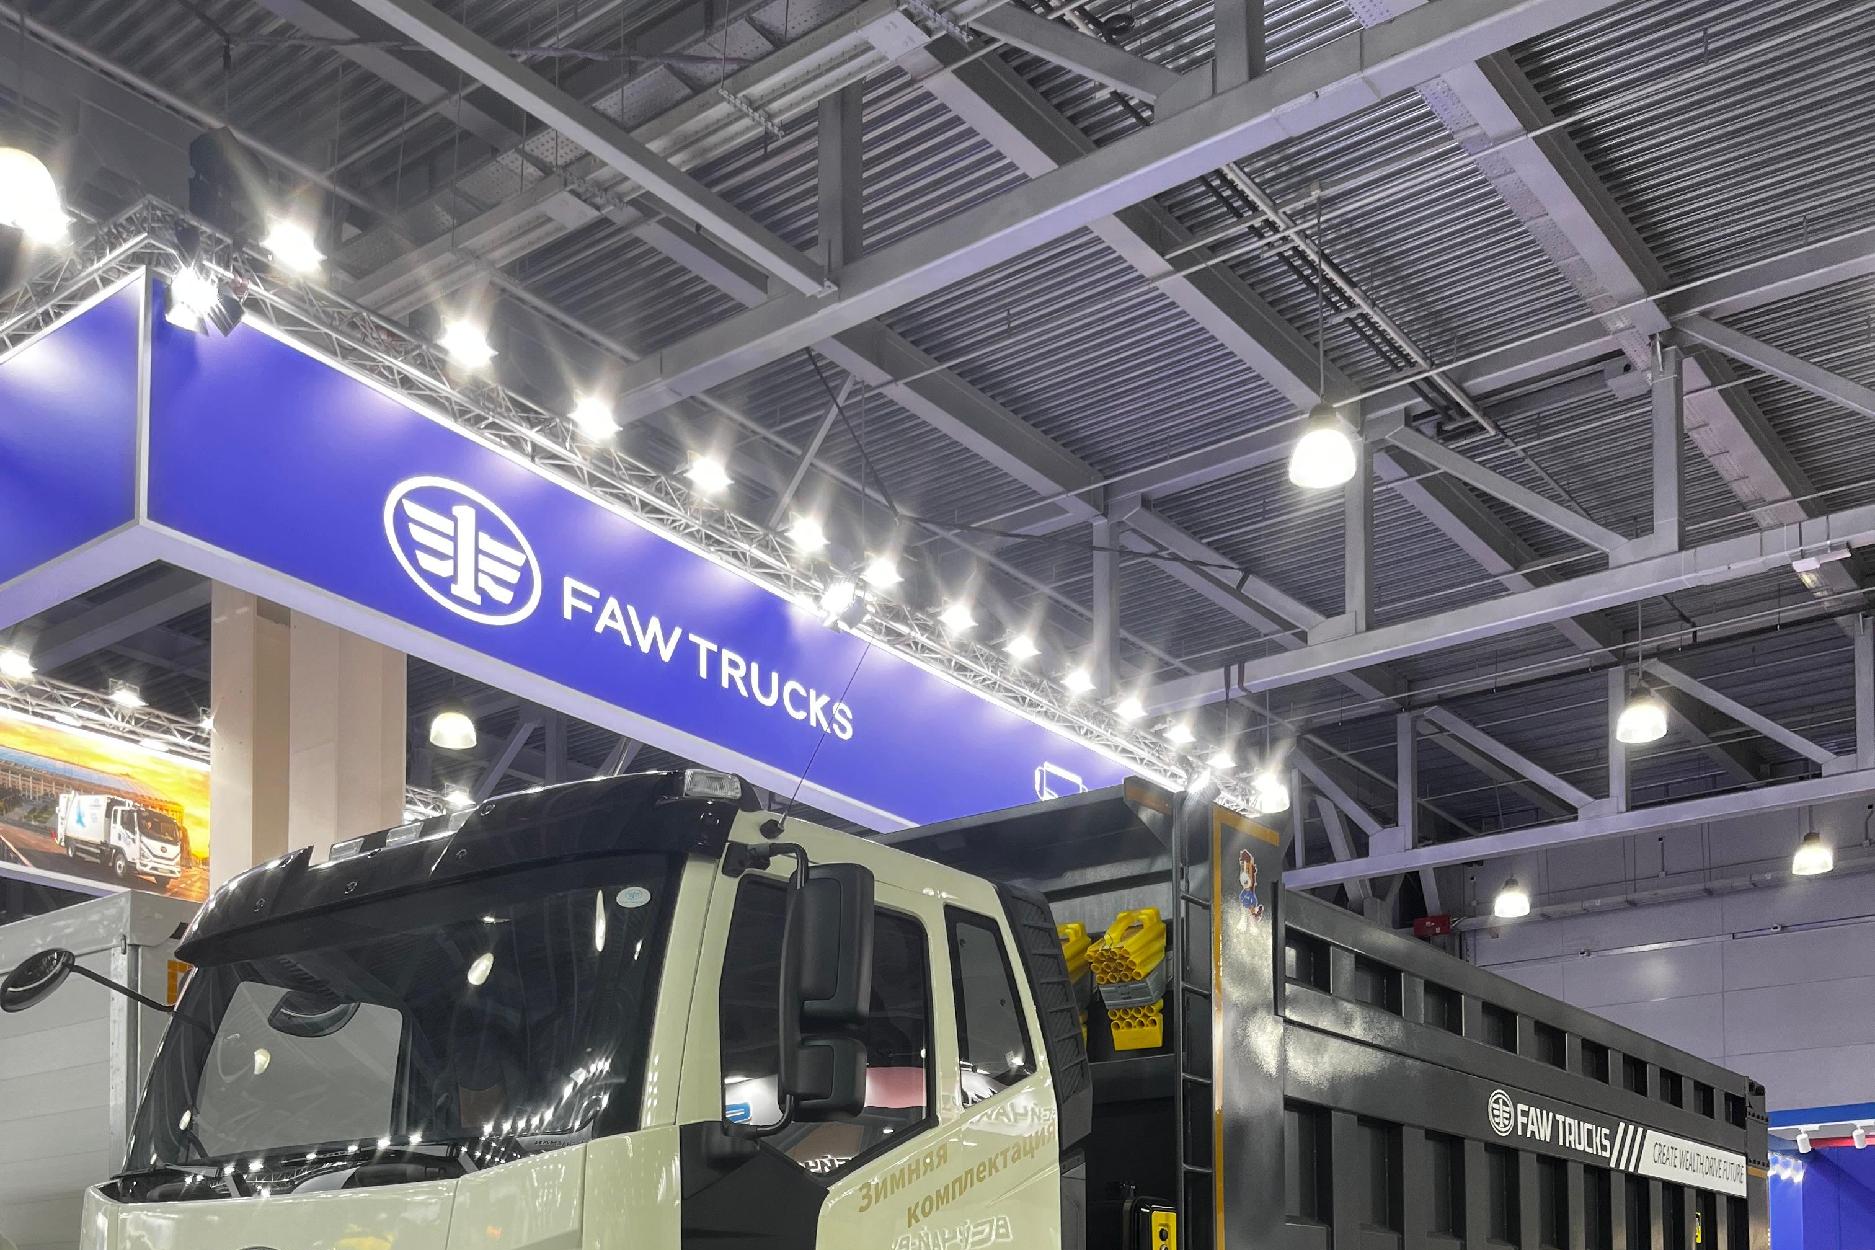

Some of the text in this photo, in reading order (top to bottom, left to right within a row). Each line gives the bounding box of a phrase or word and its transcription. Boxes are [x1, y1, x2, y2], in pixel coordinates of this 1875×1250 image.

[564, 576, 853, 741] FAW TRUCKS
[1517, 1103, 1553, 1142] FAW
[858, 1142, 948, 1213] Зимняя
[907, 1118, 1056, 1228] комплектация
[1653, 1142, 1678, 1169] CREATE
[1723, 1160, 1745, 1184] FUTURE
